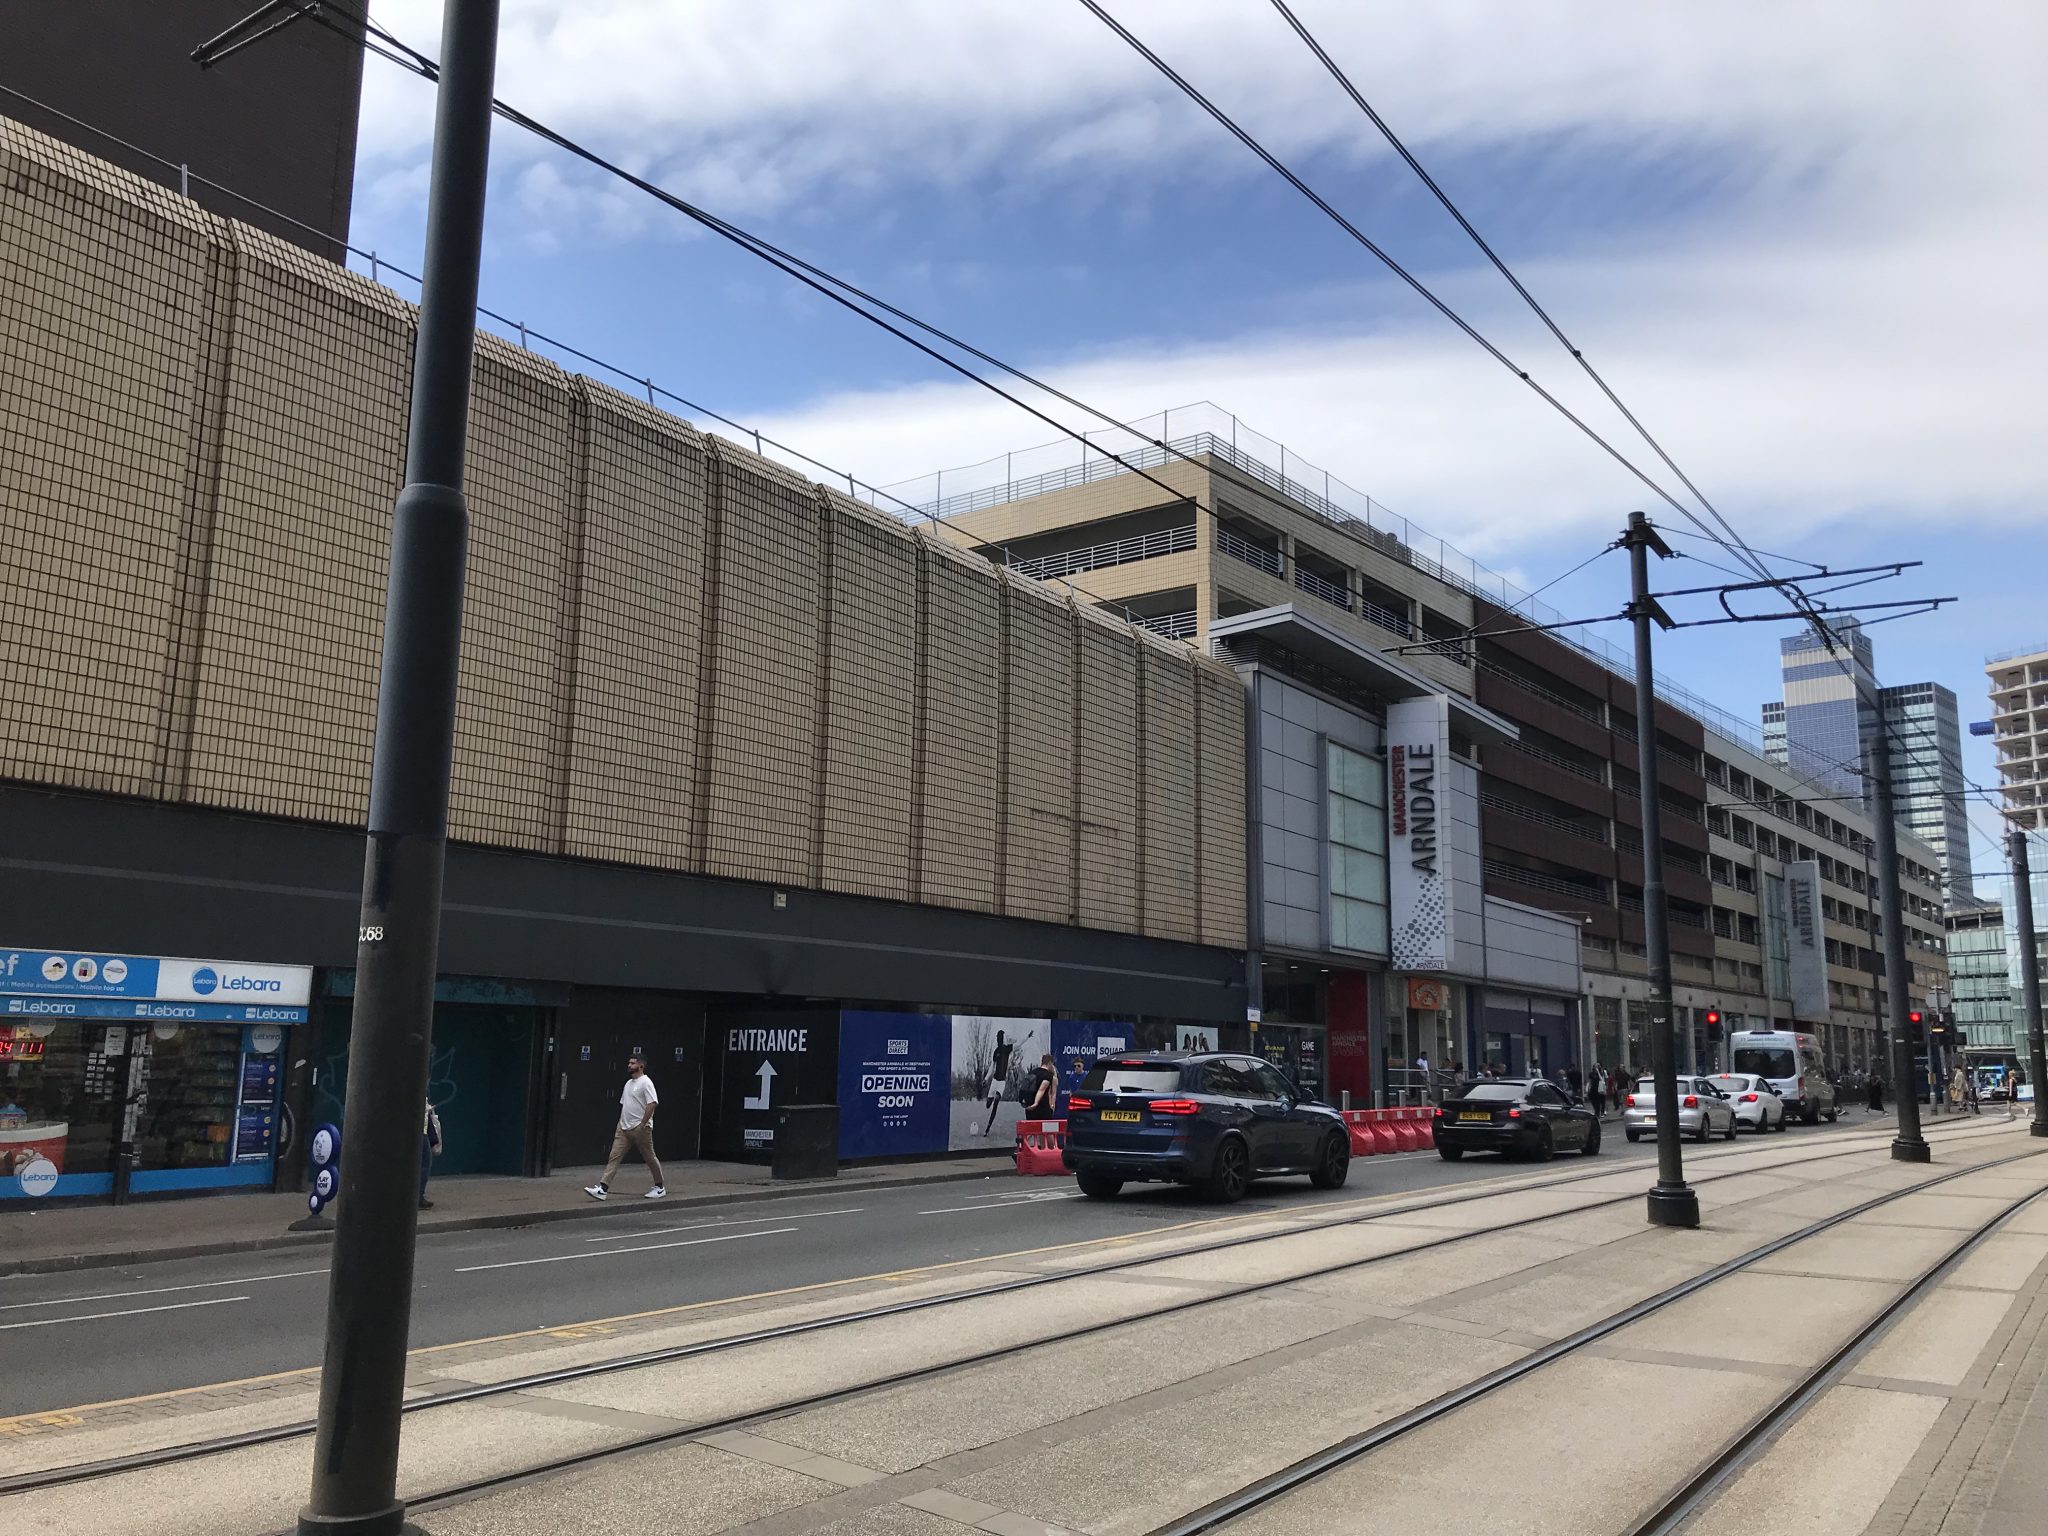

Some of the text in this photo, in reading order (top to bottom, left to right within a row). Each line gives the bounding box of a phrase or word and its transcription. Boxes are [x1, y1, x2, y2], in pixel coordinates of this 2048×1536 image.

[1392, 745, 1406, 836] MANCHESTER
[1409, 744, 1437, 874] ARNDALE
[1416, 962, 1445, 970] ARNDALE
[222, 975, 281, 992] Lebara
[23, 1001, 76, 1014] Lebara
[148, 1004, 196, 1017] Lebara
[256, 1008, 299, 1020] Lebara
[728, 1029, 808, 1052] ENTRANCE
[1301, 1041, 1315, 1051] GAME
[1062, 1046, 1080, 1055] JOIN
[1081, 1046, 1096, 1055] OUR
[863, 1076, 929, 1091] OPENING
[877, 1095, 915, 1108] SOON
[1104, 1111, 1122, 1120] YC70
[745, 1130, 772, 1139] MANCHESTER
[745, 1140, 763, 1148] ARNDALE
[23, 1173, 56, 1182] Lebara
